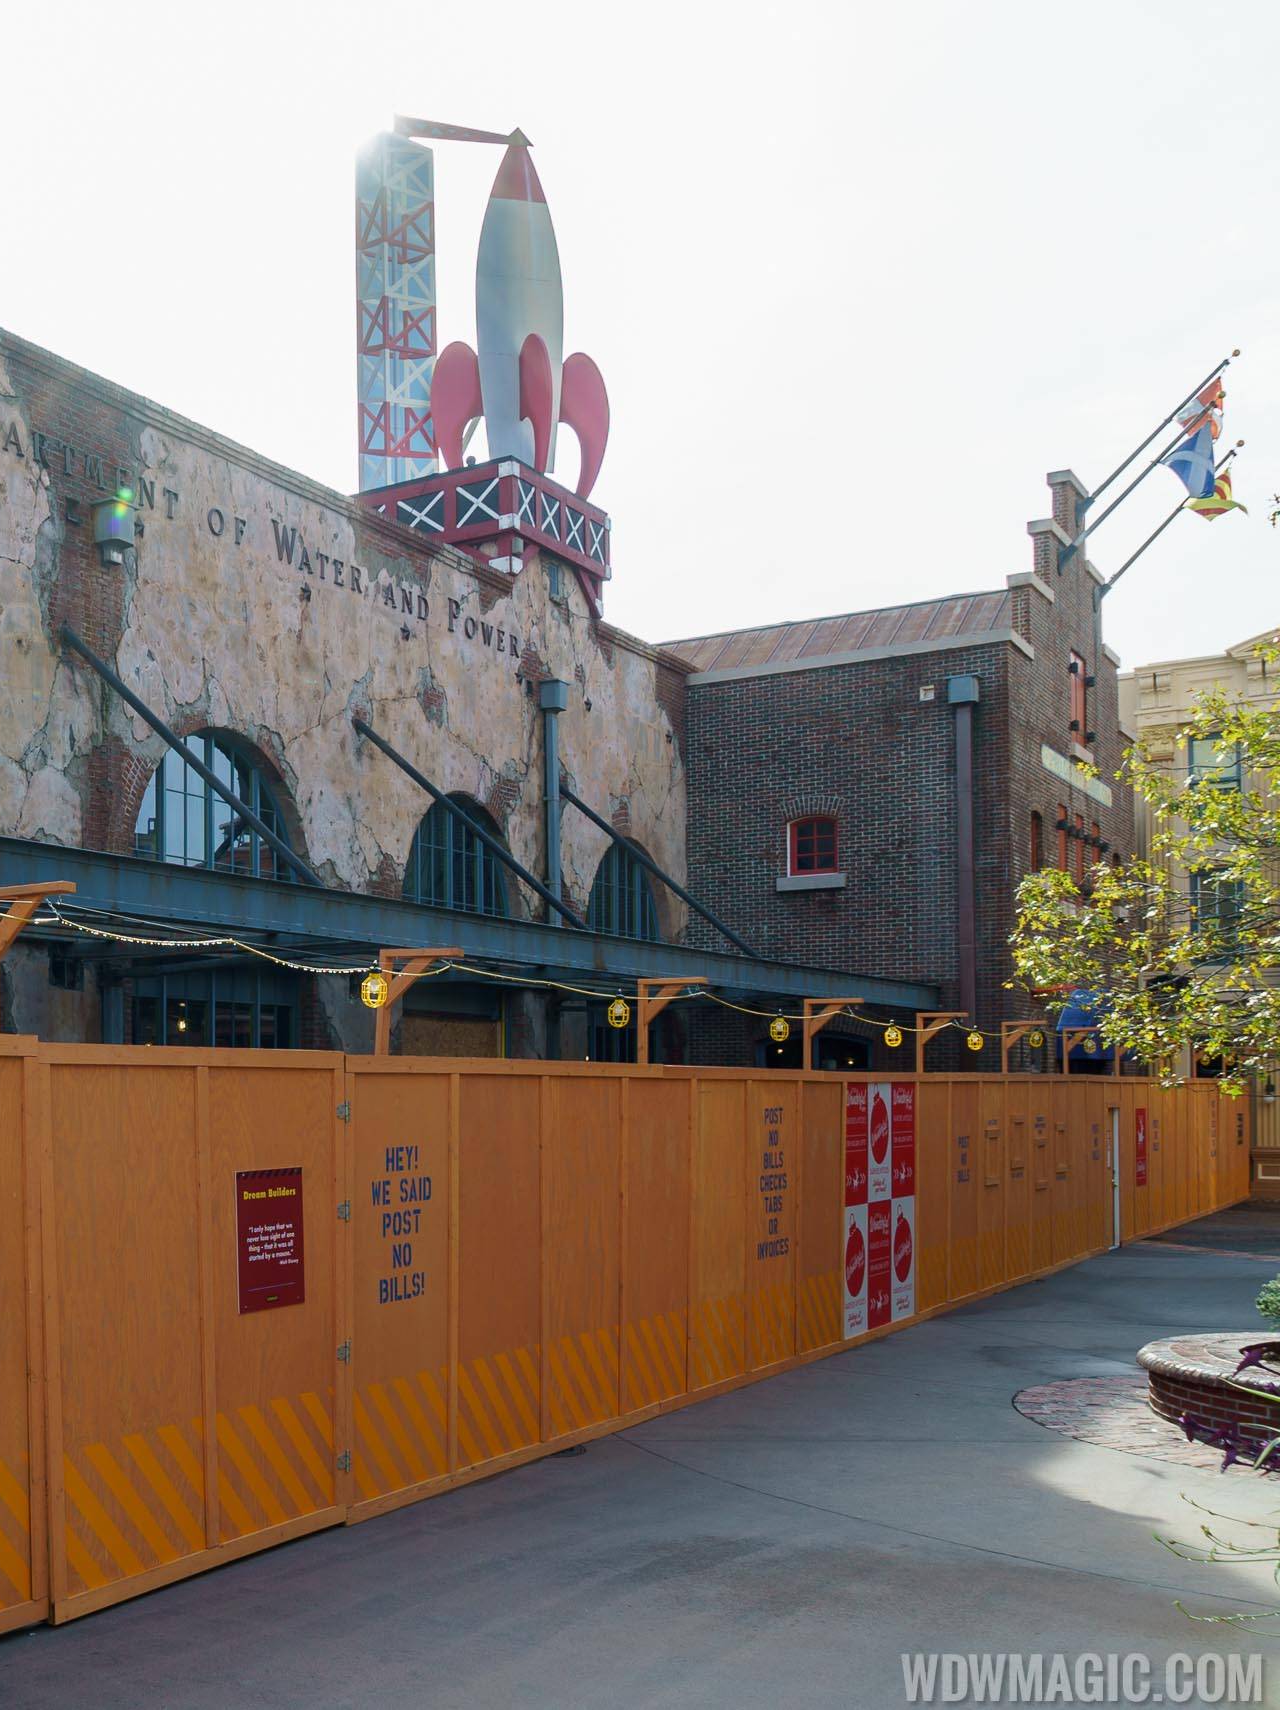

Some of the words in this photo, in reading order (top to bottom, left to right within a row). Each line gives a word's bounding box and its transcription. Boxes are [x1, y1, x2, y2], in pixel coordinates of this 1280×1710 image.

[207, 508, 247, 545] OF
[271, 518, 363, 594] WATER
[384, 582, 430, 621] AND
[447, 597, 520, 659] POWER
[764, 1108, 784, 1125] POST
[769, 1130, 779, 1147] NO
[385, 1146, 418, 1172] HEY!
[763, 1151, 784, 1170] BILLS
[243, 1190, 267, 1200] Dream
[268, 1187, 297, 1198] Builders
[372, 1180, 391, 1206] WE
[400, 1177, 432, 1203] SAID
[383, 1209, 421, 1238] POST
[392, 1242, 412, 1269] NO
[379, 1272, 425, 1304] BILLS!
